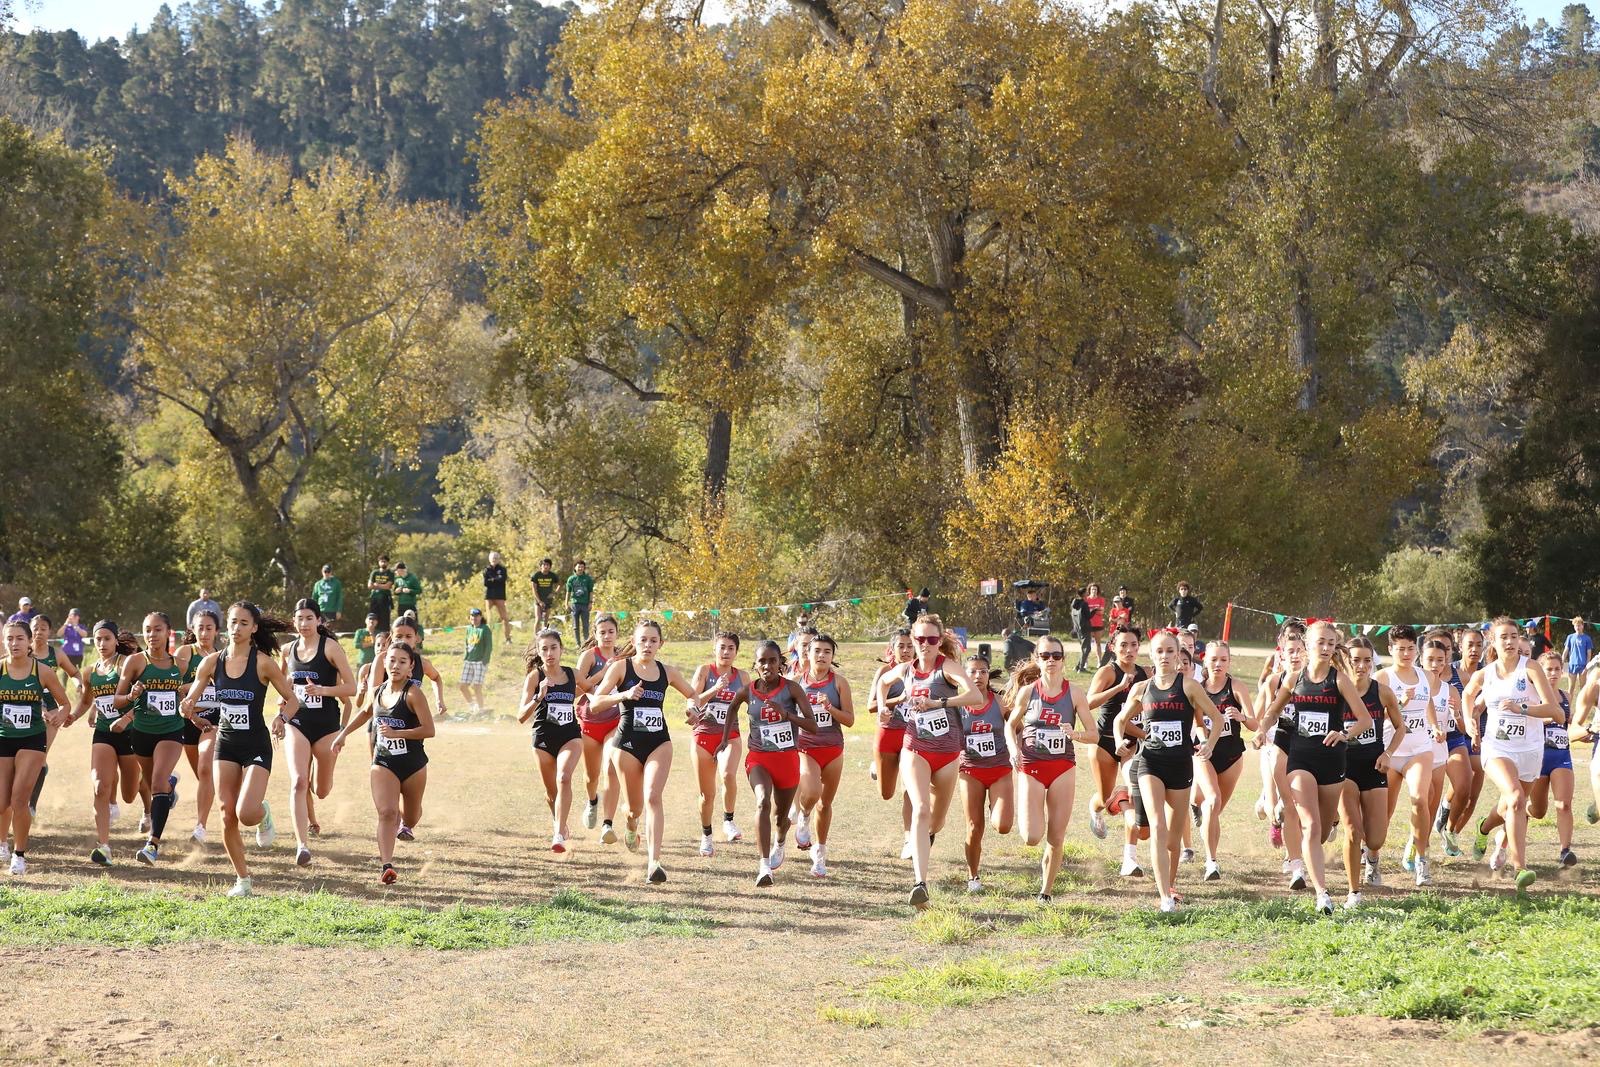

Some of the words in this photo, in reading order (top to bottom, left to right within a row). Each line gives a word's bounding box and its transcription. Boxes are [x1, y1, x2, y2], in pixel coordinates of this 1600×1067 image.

[304, 694, 320, 704] 216
[642, 690, 664, 701] USB
[1314, 696, 1337, 704] STATE
[102, 704, 116, 713] 142
[160, 701, 174, 710] 139
[1160, 701, 1184, 710] STATE
[14, 714, 30, 724] 140
[228, 714, 248, 724] 223
[557, 712, 572, 722] 218
[716, 710, 726, 720] 15
[814, 712, 830, 722] 157
[1038, 708, 1062, 726] EB
[646, 716, 662, 727] 220
[928, 718, 948, 732] 155
[1308, 721, 1326, 732] 294
[1409, 718, 1424, 729] 274
[1506, 724, 1525, 736] 279
[774, 730, 792, 744] 153
[1162, 730, 1182, 742] 293
[1555, 736, 1568, 745] 268
[386, 739, 406, 750] 219
[977, 741, 994, 752] 156
[1048, 738, 1064, 748] 161
